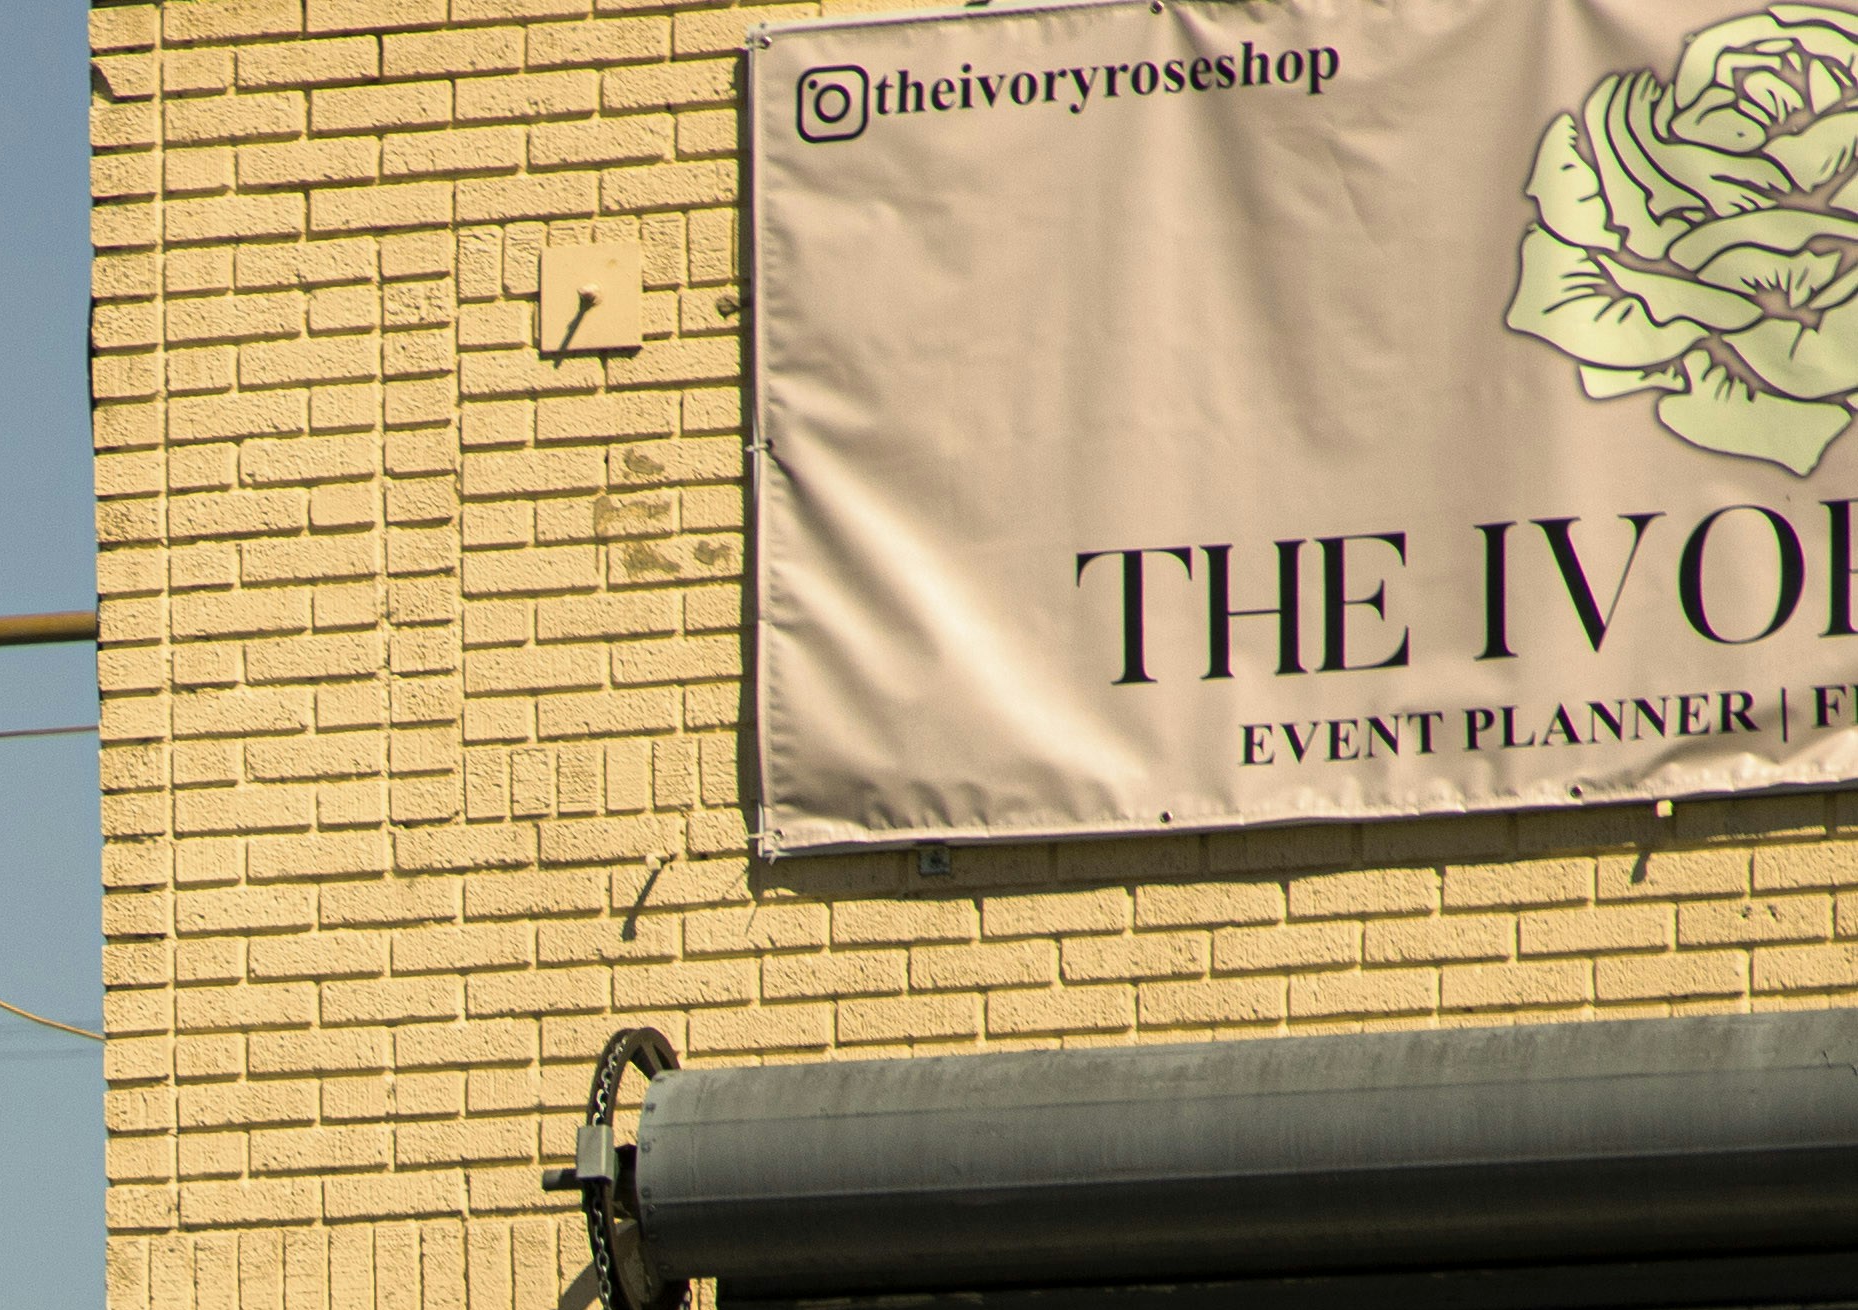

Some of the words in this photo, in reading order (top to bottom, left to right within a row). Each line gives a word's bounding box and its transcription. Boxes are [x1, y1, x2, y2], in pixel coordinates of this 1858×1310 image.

[875, 38, 1340, 117] theivoryroseshop
[1076, 532, 1410, 686] THE
[1240, 711, 1445, 767] EVENT
[1463, 690, 1759, 752] PLANNER
[1812, 681, 1858, 730] F
